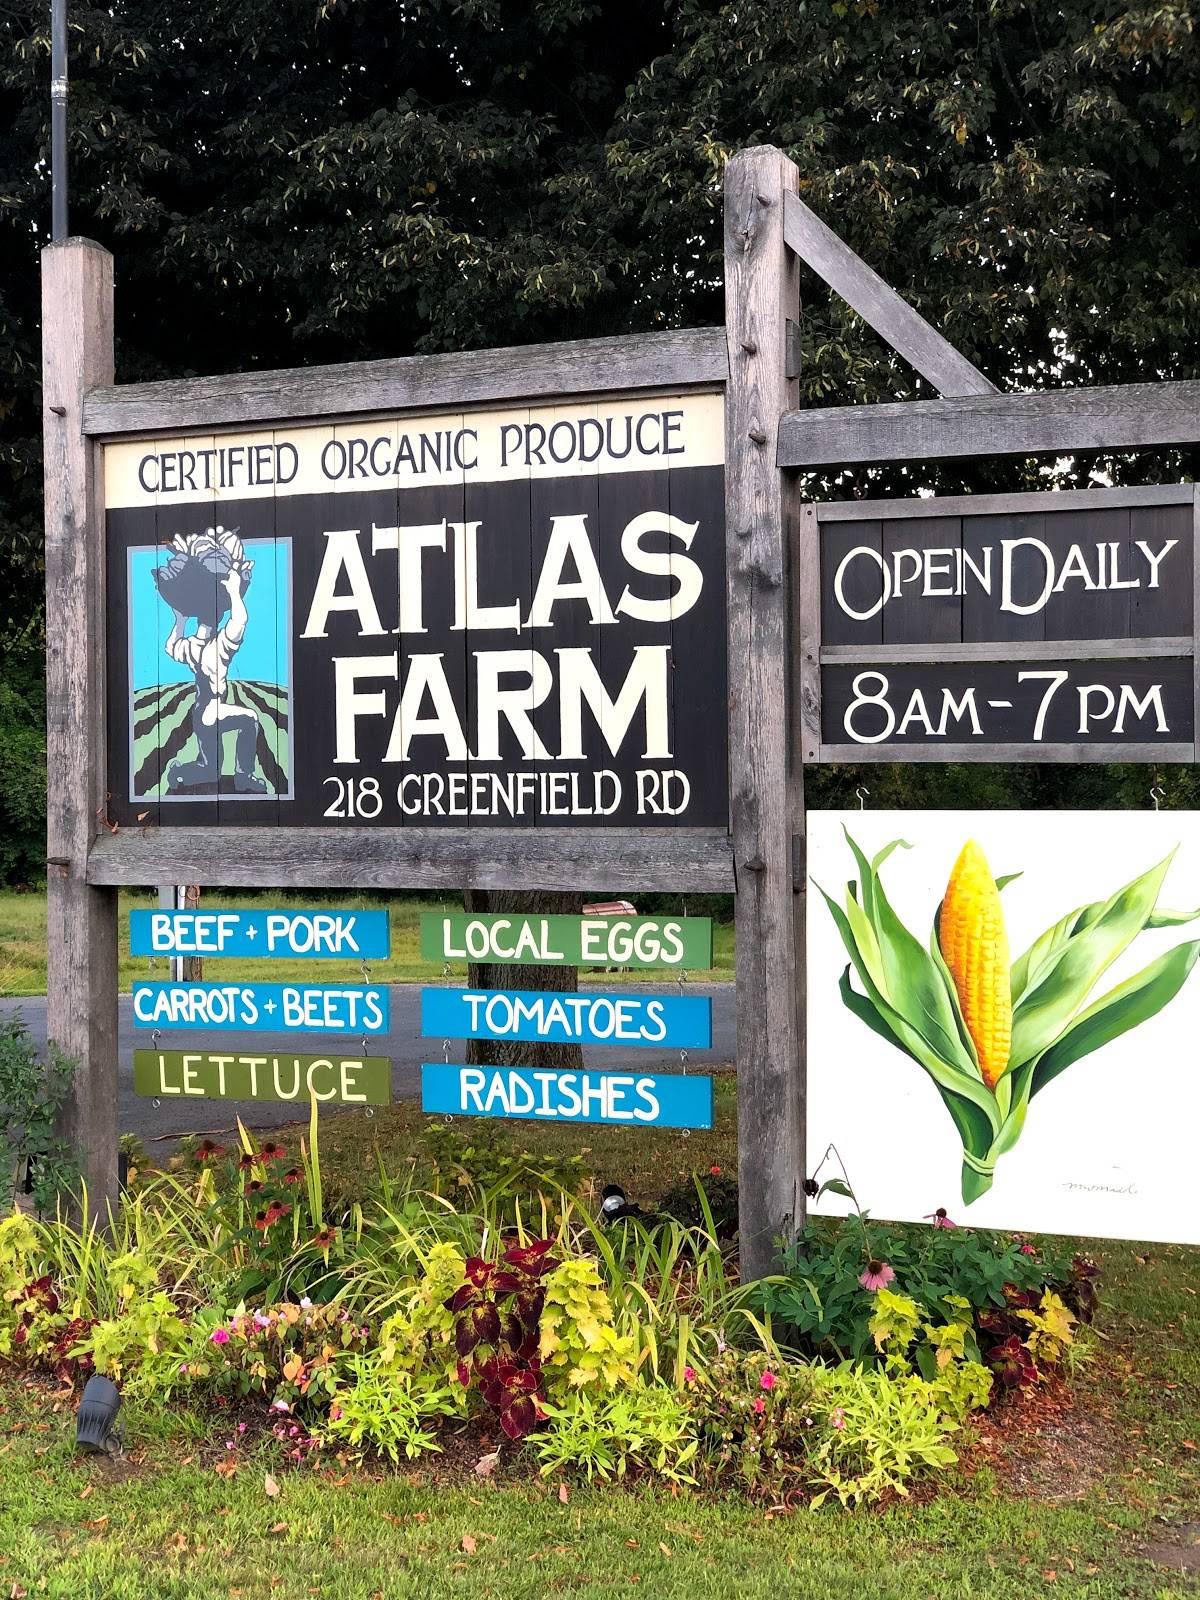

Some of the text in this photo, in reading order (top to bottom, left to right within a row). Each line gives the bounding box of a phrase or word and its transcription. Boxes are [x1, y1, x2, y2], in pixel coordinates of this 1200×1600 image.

[139, 411, 686, 492] CERTIFIED ORGANIC PRODUCE
[300, 510, 705, 639] ATLAS
[332, 645, 674, 763] FARM
[323, 770, 692, 818] 218 GREENFIELD RD
[151, 914, 240, 951] BEEF
[267, 915, 360, 952] PORK
[443, 918, 685, 963] LOCAL EGGS
[133, 988, 258, 1023] CARROTS
[283, 989, 384, 1029] BEETS
[462, 994, 667, 1041] TOMATOES
[158, 1054, 367, 1102] LETTUCE
[459, 1068, 660, 1121] RADISHES
